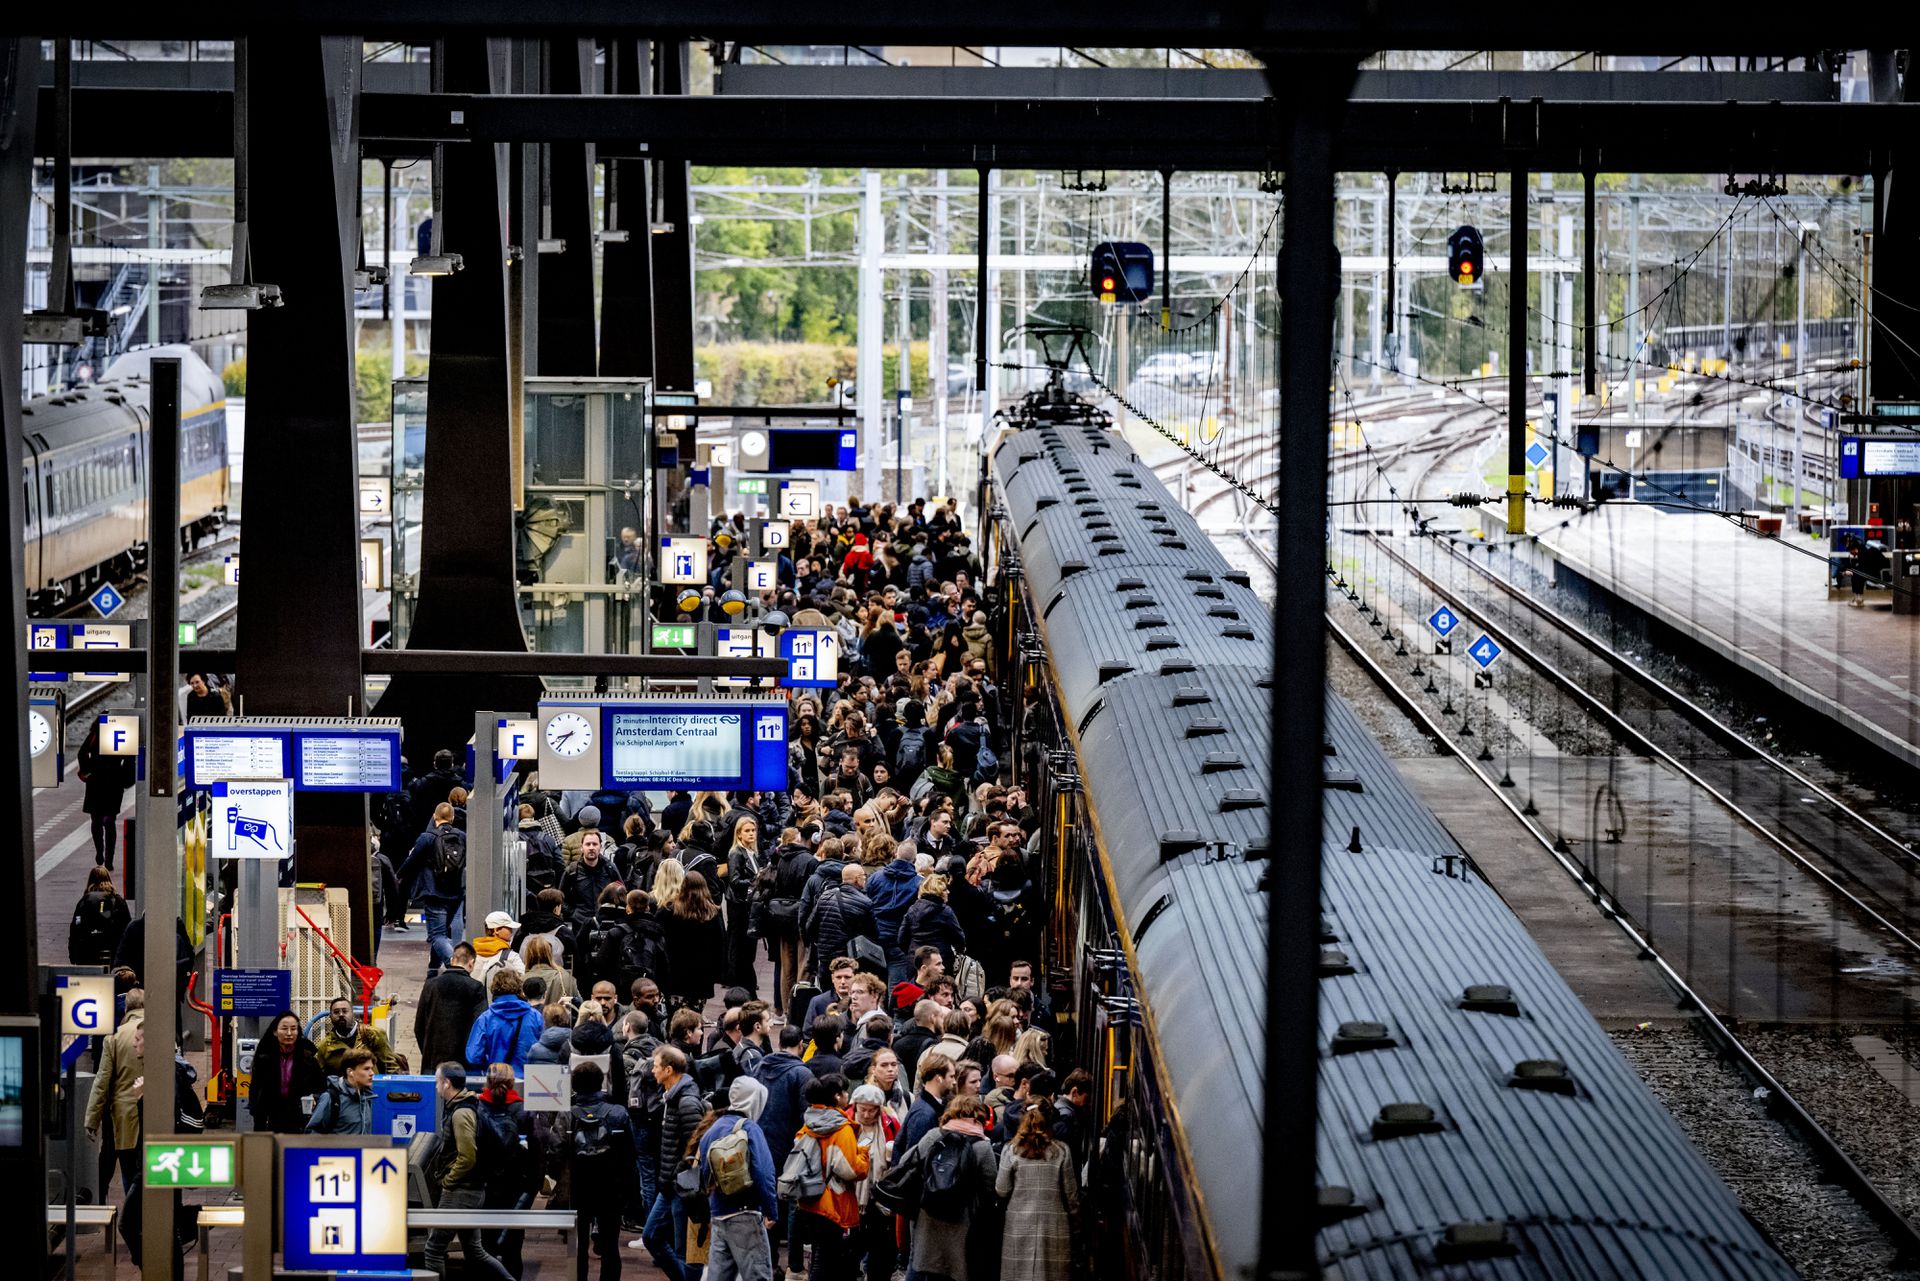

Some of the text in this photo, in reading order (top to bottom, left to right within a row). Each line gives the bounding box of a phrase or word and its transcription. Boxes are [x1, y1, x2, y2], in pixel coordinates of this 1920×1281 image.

[771, 532, 782, 545] D
[757, 573, 767, 587] E
[101, 593, 113, 608] 8
[1437, 613, 1450, 629] 8
[1476, 643, 1491, 659] 4
[615, 715, 621, 724] 3
[649, 715, 688, 726] Intercity
[690, 715, 717, 724] direct
[615, 727, 718, 736] Amsterdam Centraal
[113, 730, 126, 751] F
[512, 734, 525, 756] F
[229, 788, 282, 797] overstappen
[71, 998, 98, 1029] G
